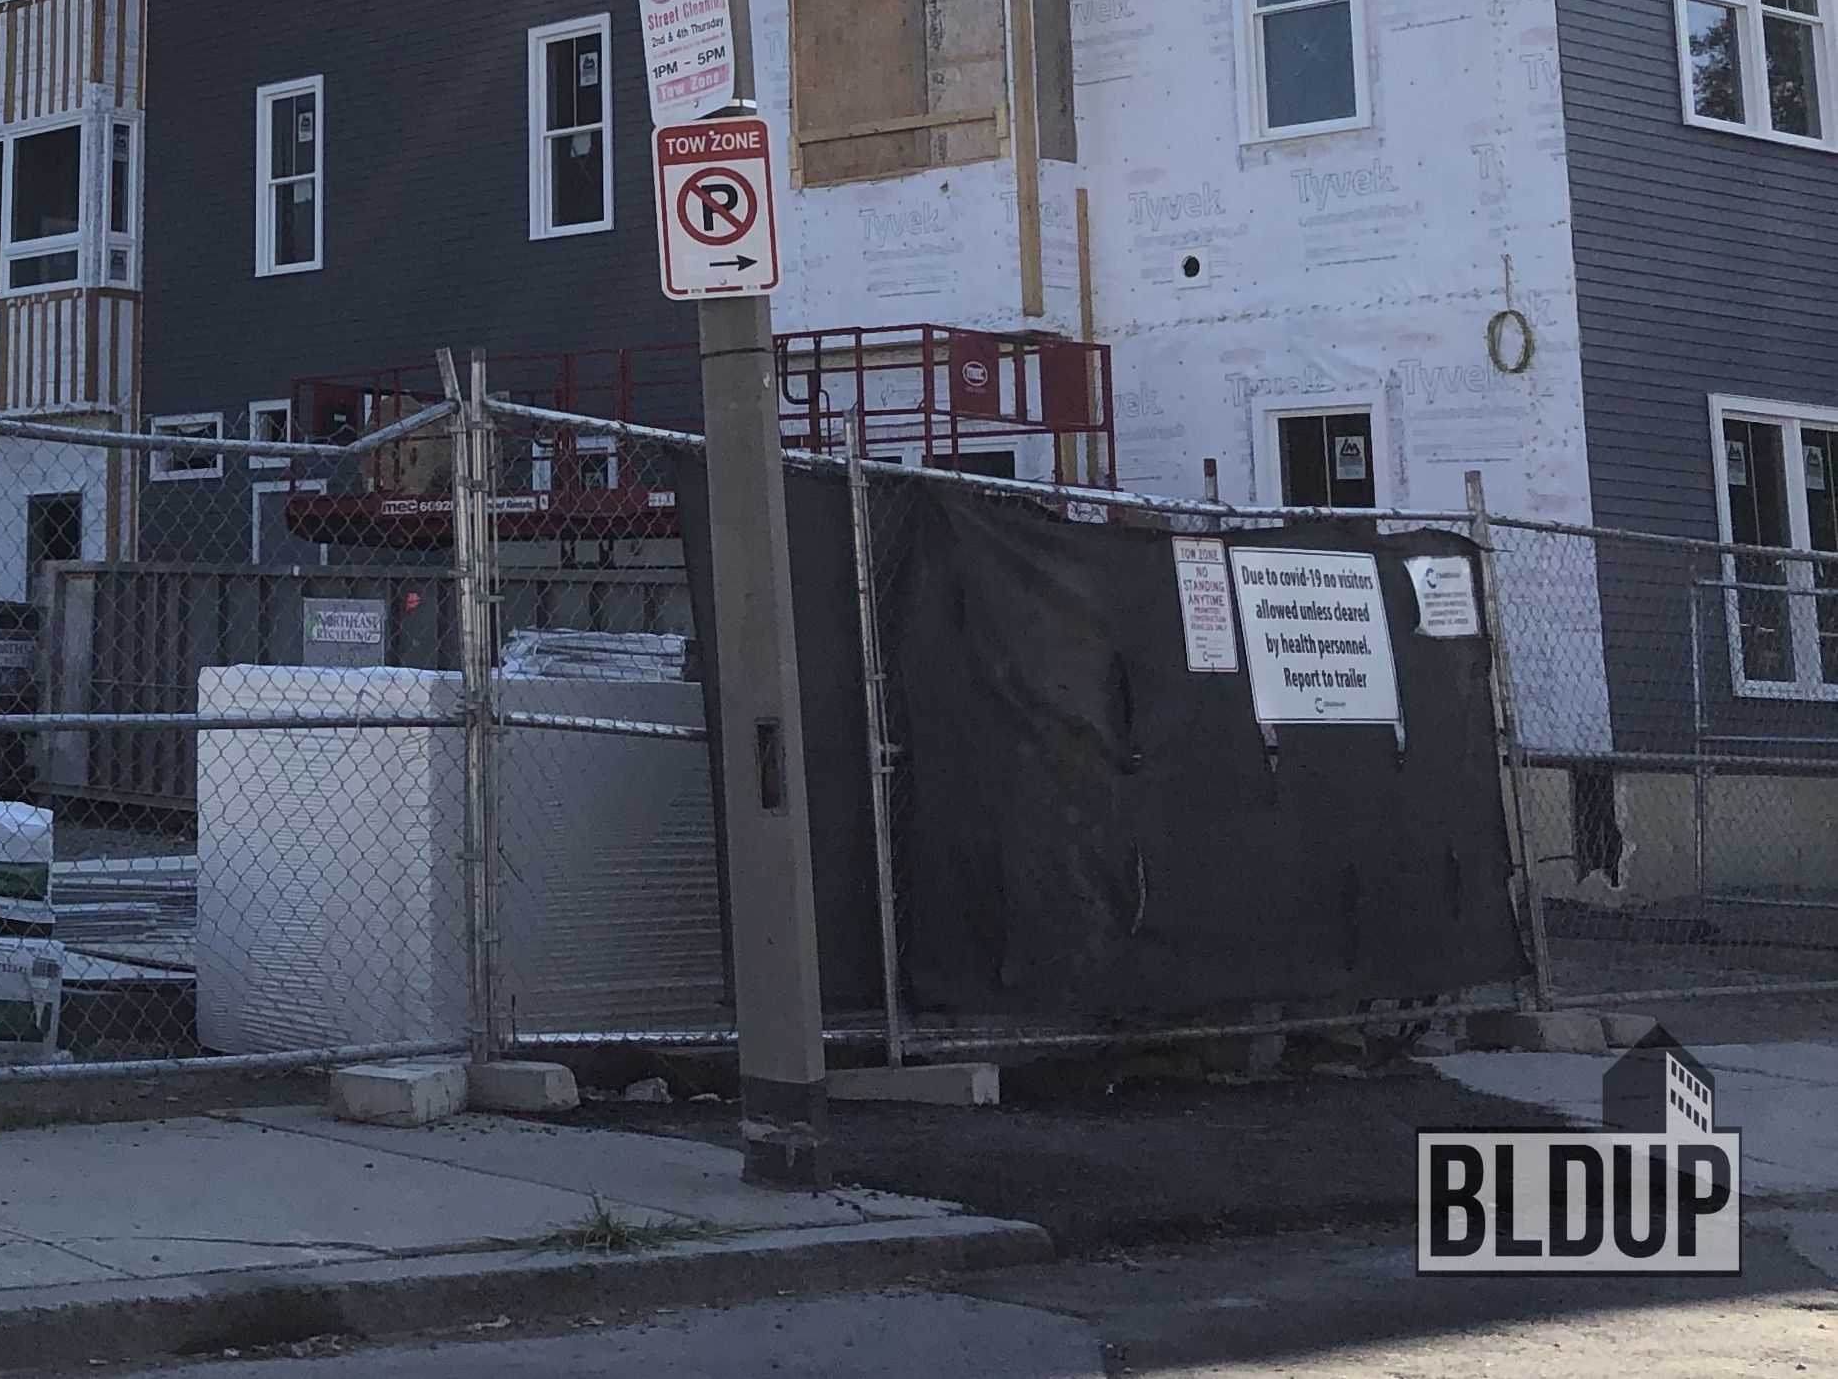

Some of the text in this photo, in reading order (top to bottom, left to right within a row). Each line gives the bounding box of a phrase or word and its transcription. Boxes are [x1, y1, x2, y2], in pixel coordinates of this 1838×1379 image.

[648, 6, 679, 31] Street
[652, 17, 724, 48] 2nd & 4th Thursday
[652, 61, 678, 79] 1PM
[697, 45, 725, 66] 5PM
[661, 72, 720, 100] Tow Zone
[665, 131, 761, 155] TOW ZONE
[1290, 158, 1399, 210] Tyvek
[1128, 181, 1226, 231] Tyvek
[859, 201, 945, 246] Tyvek
[1398, 357, 1514, 402] Tyvek
[1180, 547, 1219, 562] TOW ZONE
[1196, 566, 1208, 578] NO
[1241, 565, 1374, 590] Due to covid-19 no visitors
[1183, 579, 1225, 593] STANDING
[1188, 593, 1224, 607] ANYTIME
[1256, 599, 1370, 622] allowed unless cleared
[1265, 632, 1372, 659] by health personnel.
[1284, 667, 1367, 692] Report to trailer
